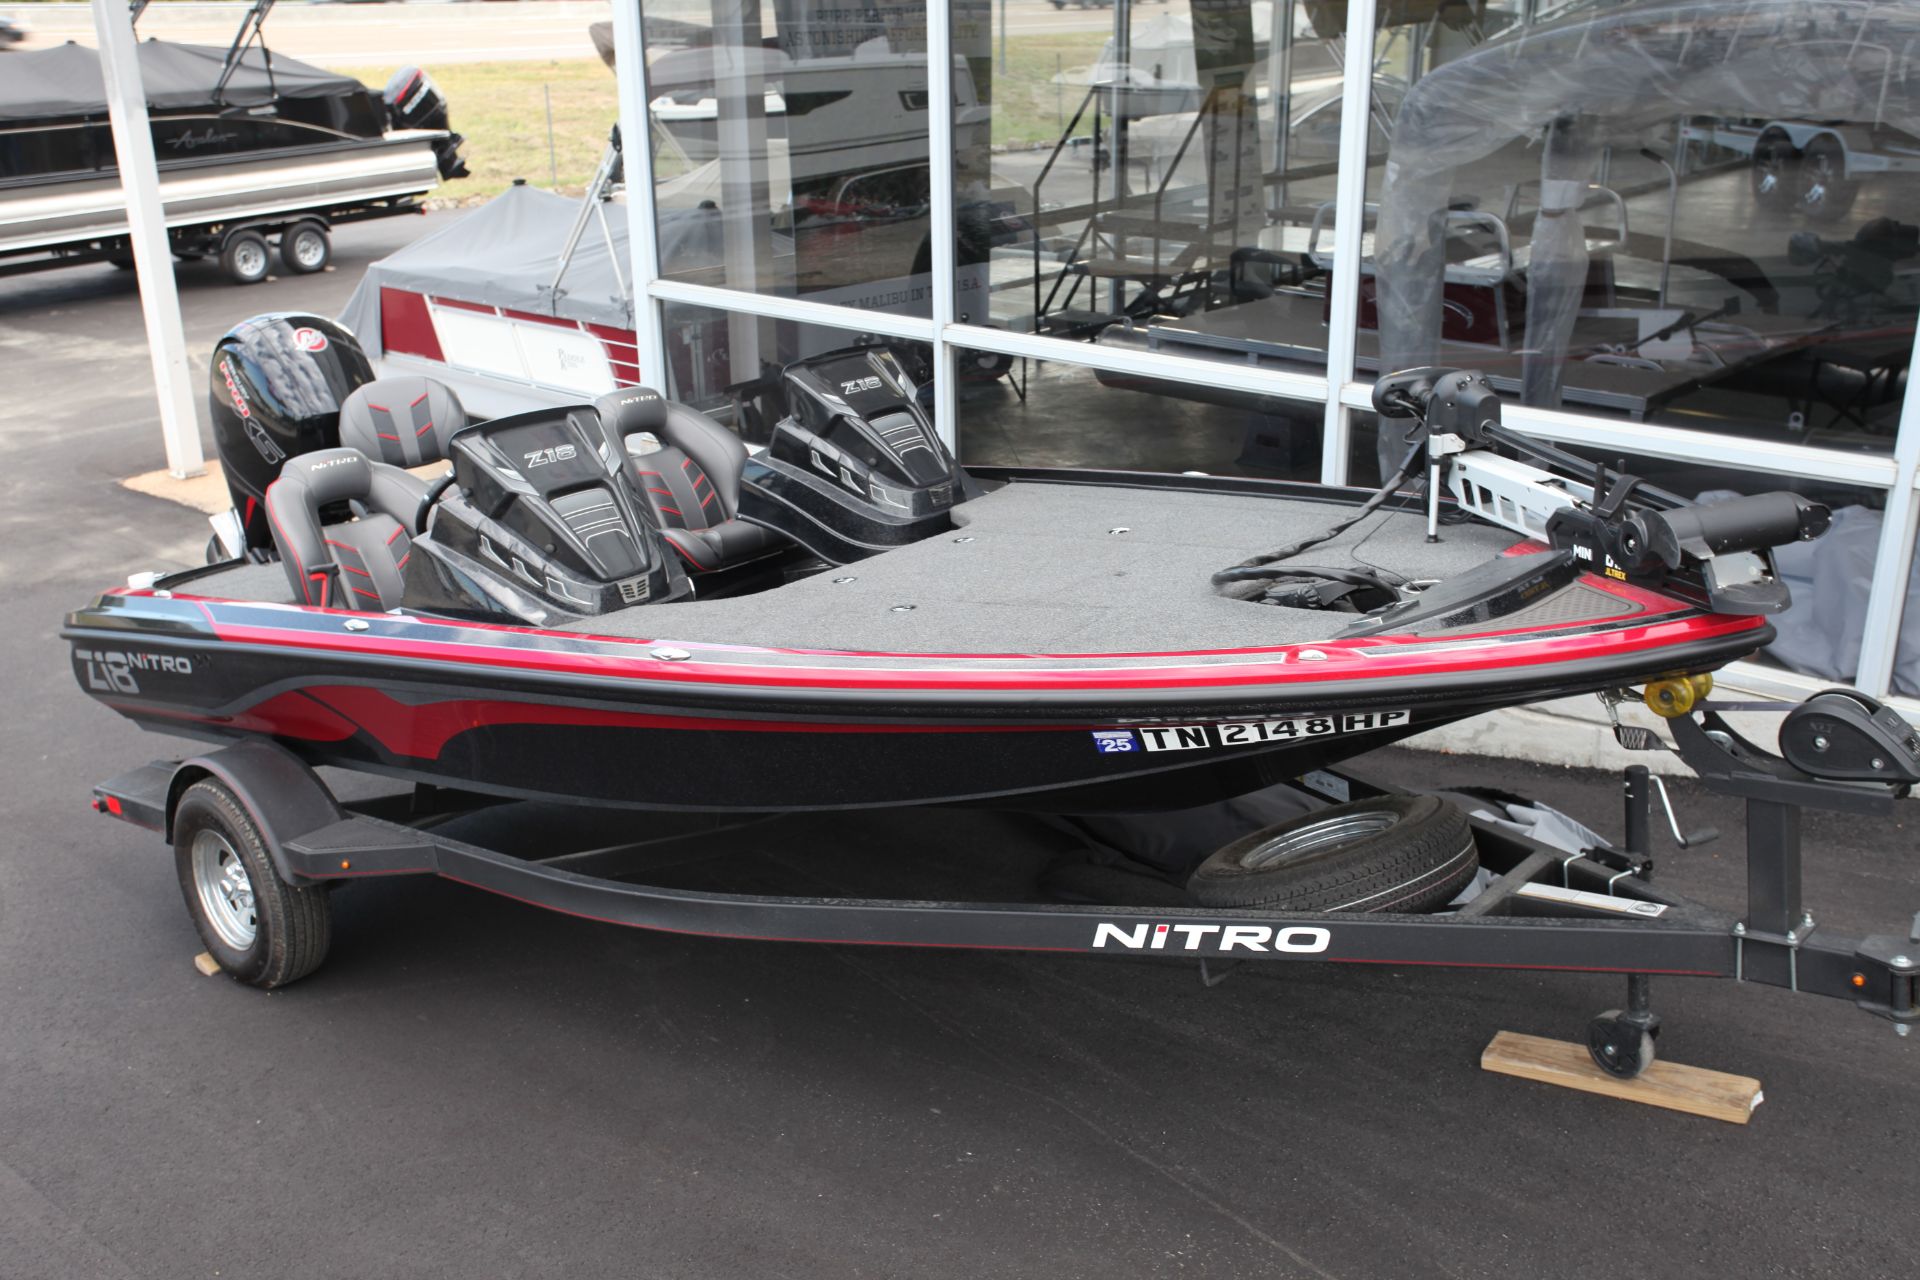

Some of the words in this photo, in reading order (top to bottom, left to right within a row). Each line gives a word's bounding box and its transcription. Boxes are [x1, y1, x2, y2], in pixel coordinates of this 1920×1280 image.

[858, 291, 908, 309] MALIBU
[840, 375, 882, 395] Z18
[523, 443, 577, 469] Z18
[75, 649, 140, 694] Z18
[126, 652, 193, 674] NITRO
[1143, 728, 1208, 750] TN
[1223, 718, 1332, 743] 2148
[1345, 711, 1406, 731] HP
[1101, 738, 1132, 752] 25
[1092, 923, 1331, 953] NITRO
